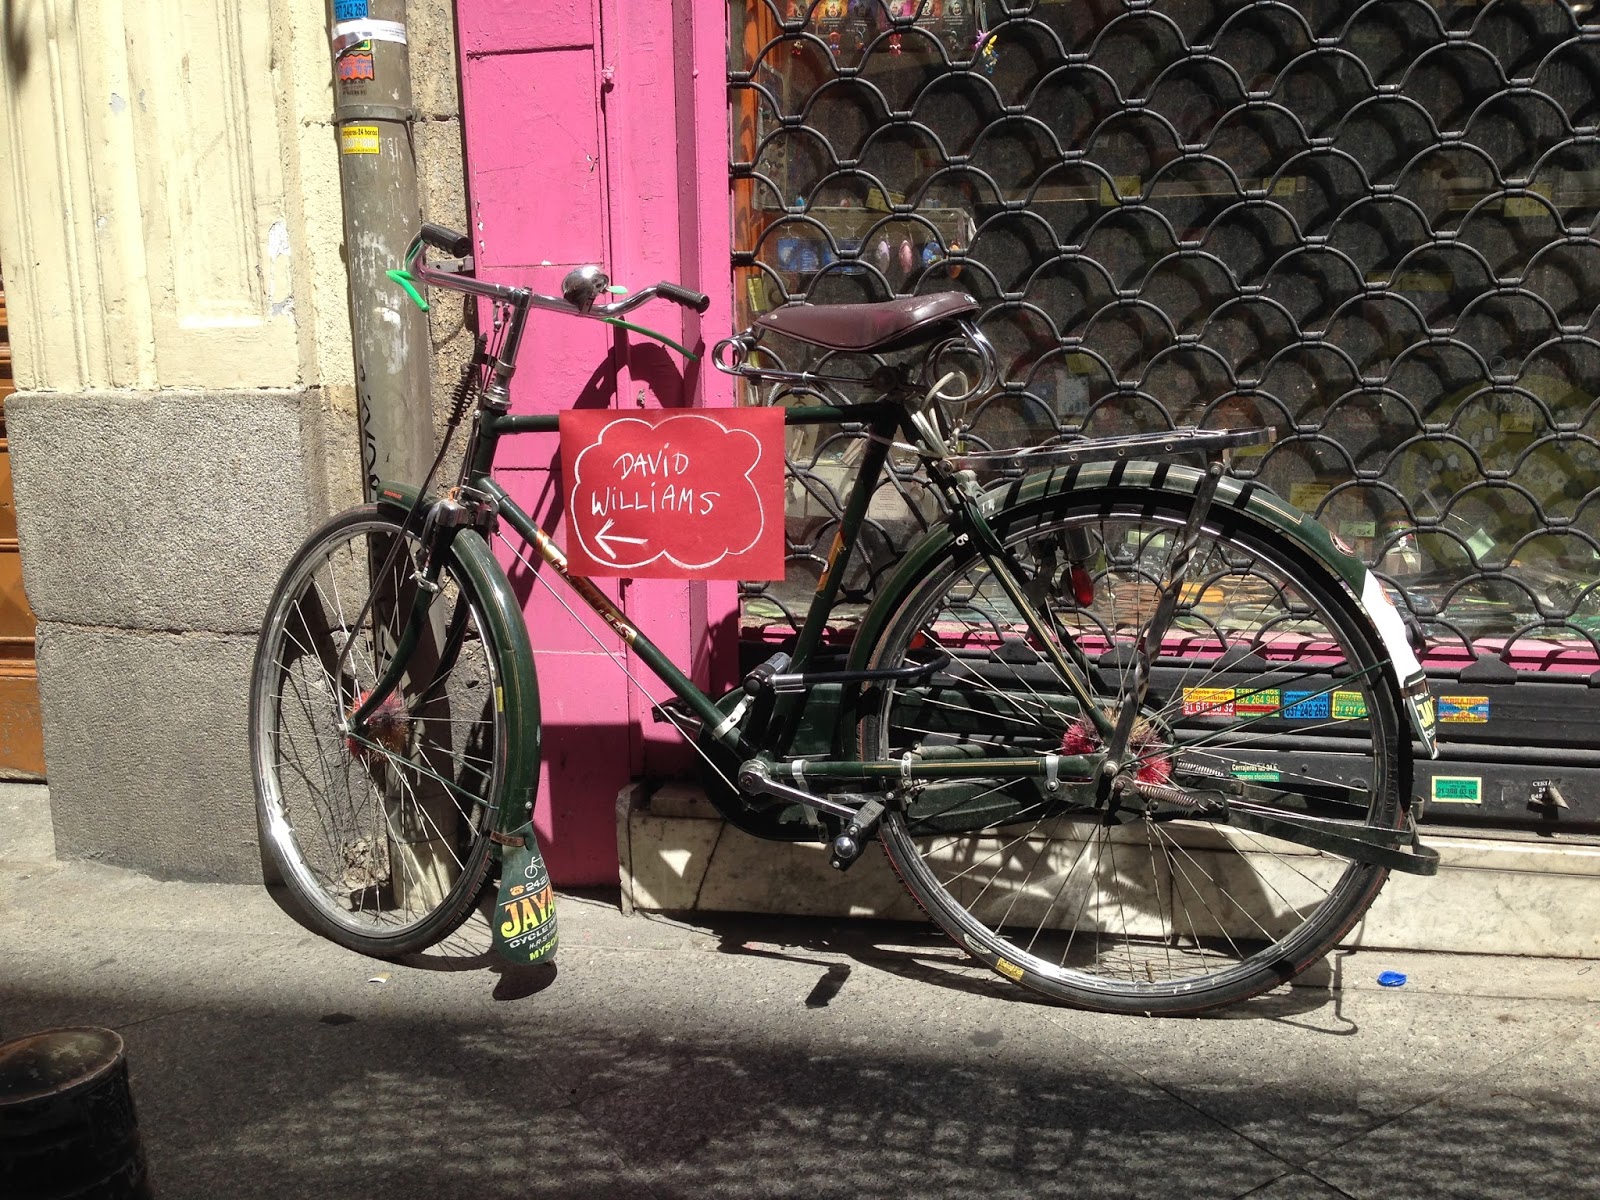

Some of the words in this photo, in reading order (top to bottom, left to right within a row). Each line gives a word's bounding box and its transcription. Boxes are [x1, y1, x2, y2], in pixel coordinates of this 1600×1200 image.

[343, 4, 353, 17] 242
[355, 3, 366, 16] 262
[612, 442, 689, 480] DAVID
[591, 481, 720, 516] WILLIAMS
[1224, 703, 1234, 712] 32
[1251, 695, 1264, 704] 264
[1266, 696, 1280, 705] 948
[1300, 704, 1312, 717] 242
[1314, 704, 1327, 717] 262
[501, 886, 555, 938] JAYA
[509, 925, 549, 949] CYCLE
